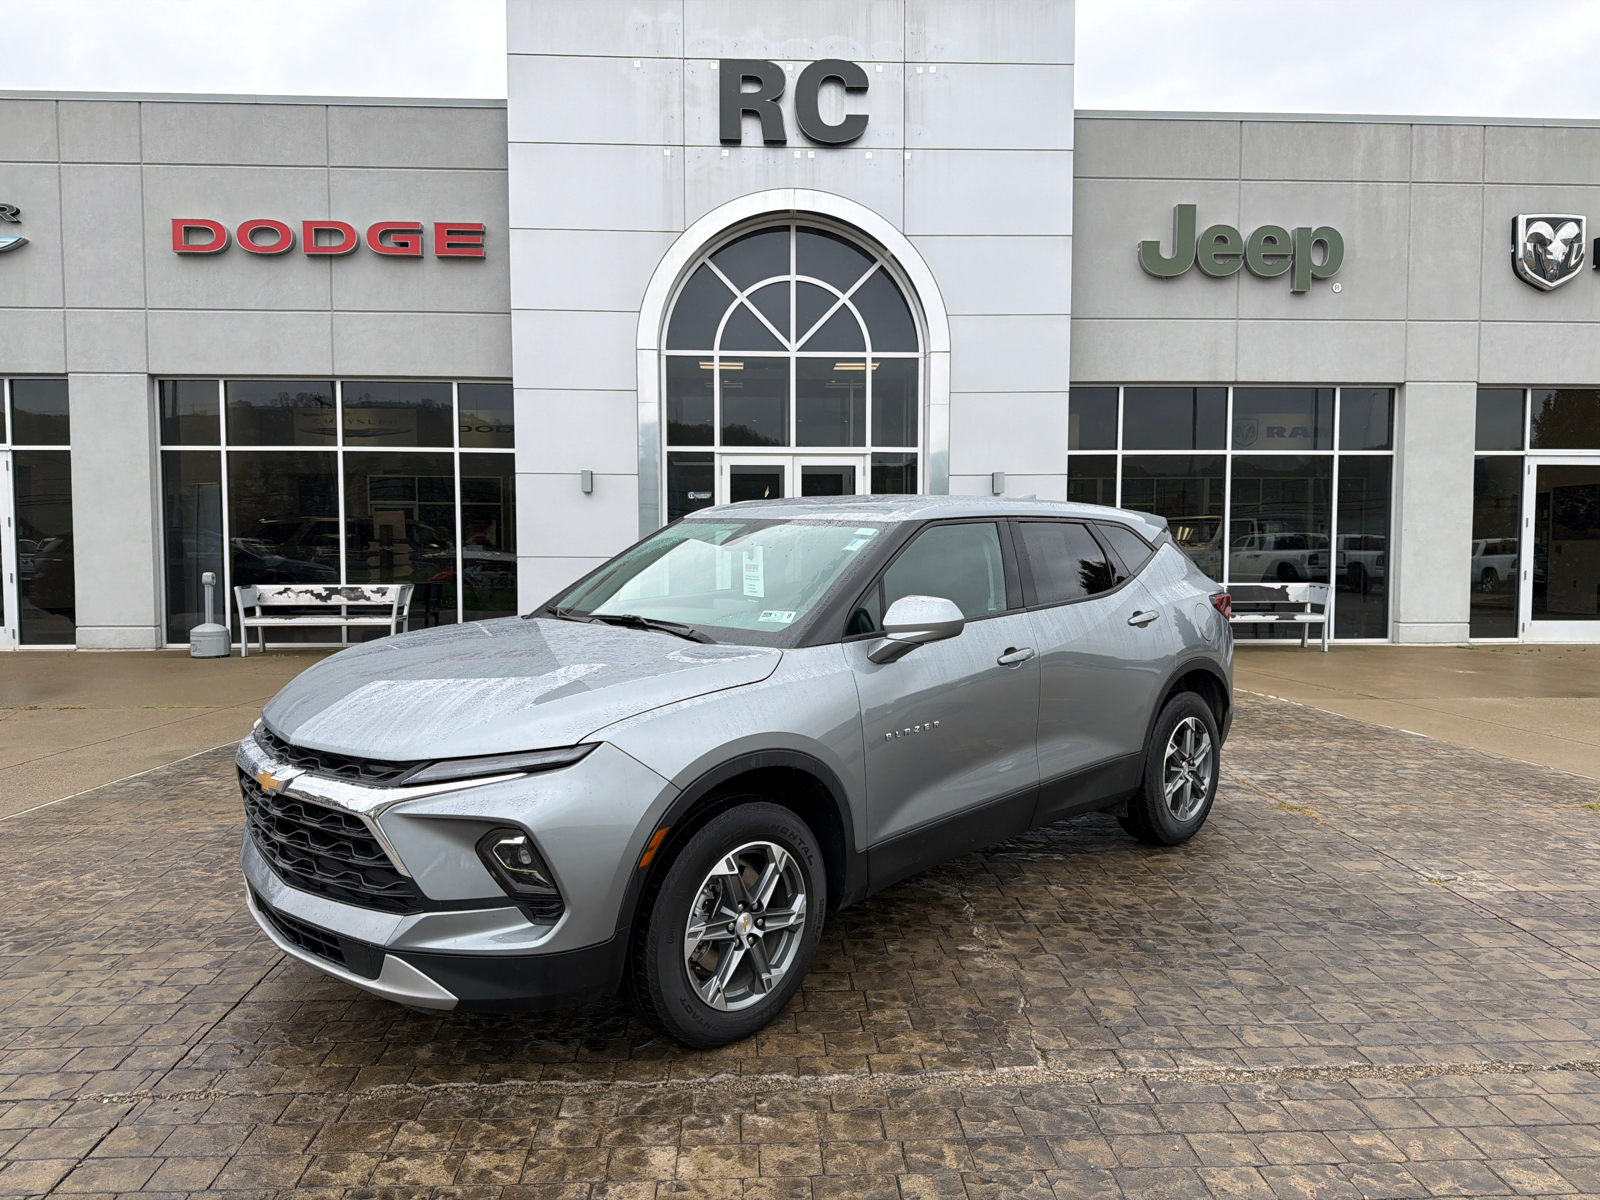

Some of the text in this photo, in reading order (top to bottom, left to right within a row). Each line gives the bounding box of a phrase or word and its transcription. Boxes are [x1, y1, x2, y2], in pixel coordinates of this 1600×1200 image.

[719, 59, 869, 145] RC
[171, 218, 486, 259] DODGE
[1138, 204, 1344, 293] Jeep
[885, 720, 940, 741] BLAZER
